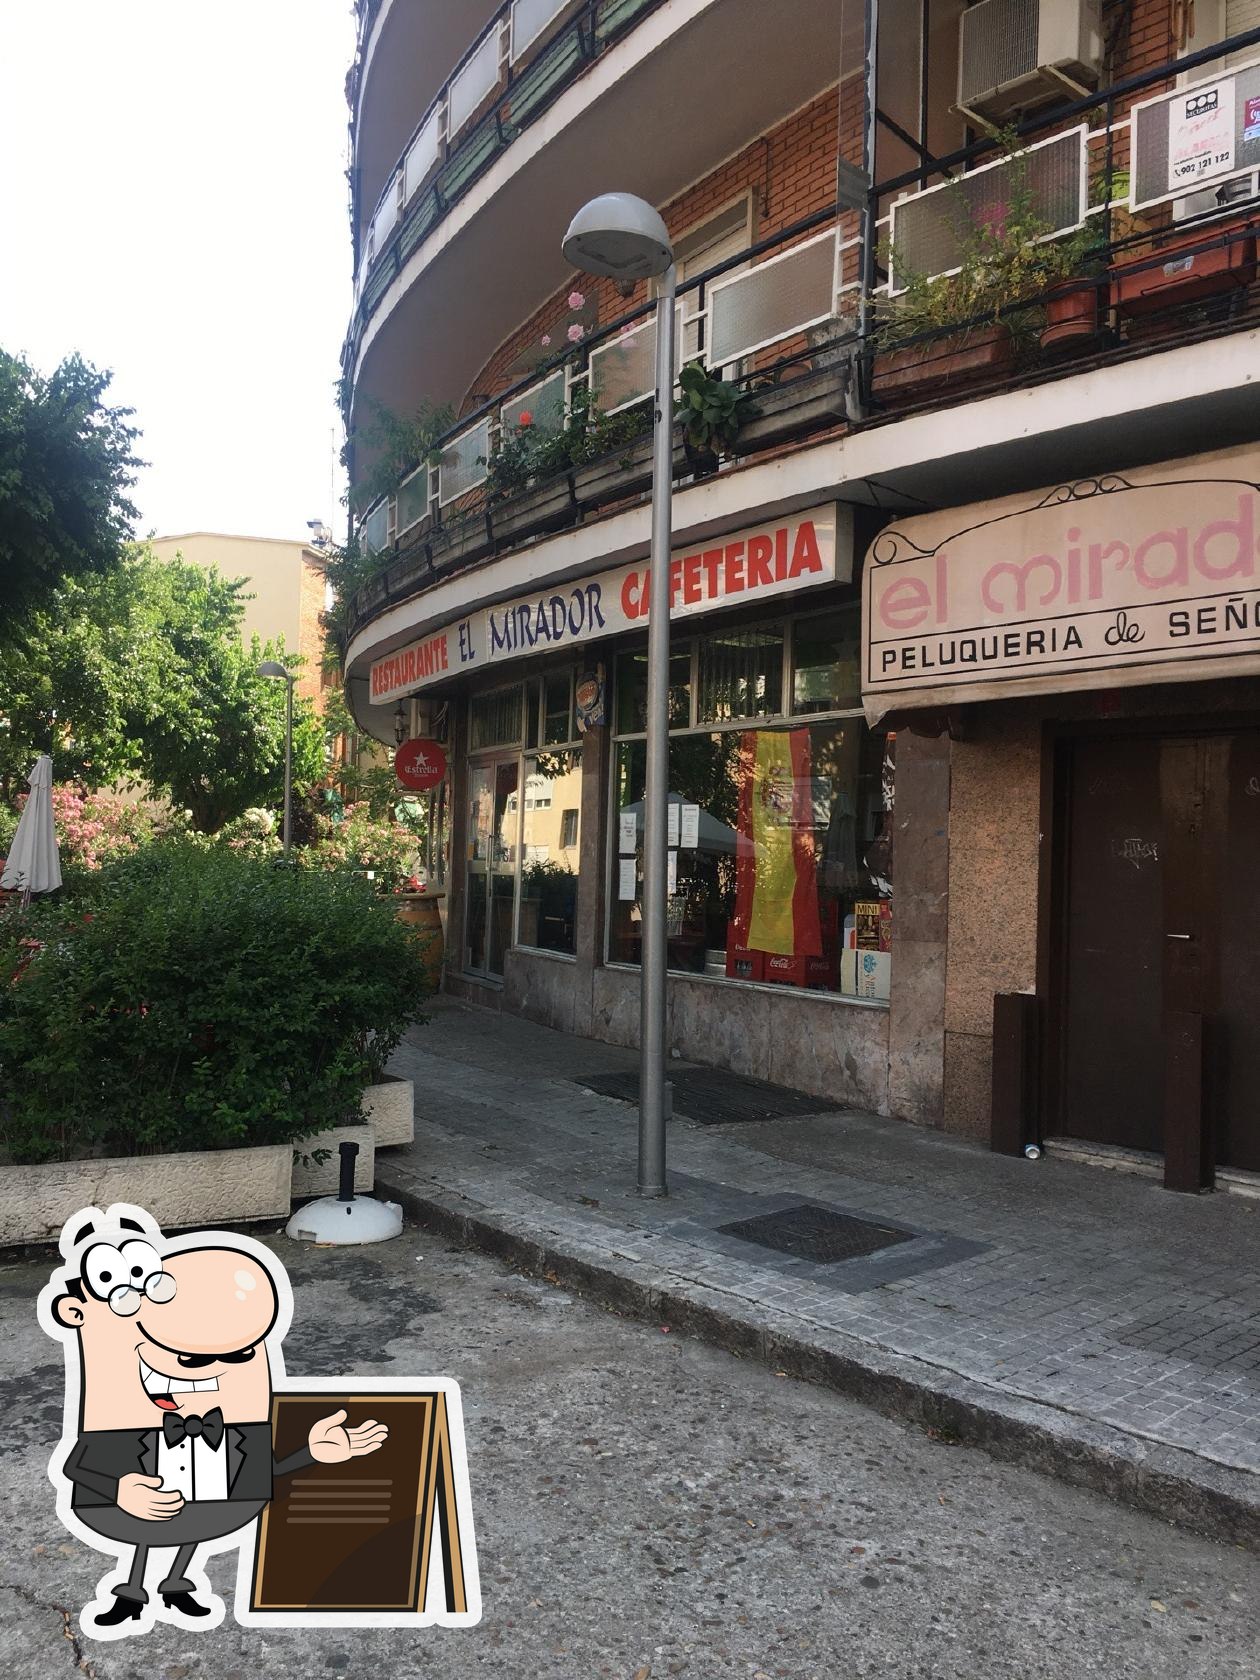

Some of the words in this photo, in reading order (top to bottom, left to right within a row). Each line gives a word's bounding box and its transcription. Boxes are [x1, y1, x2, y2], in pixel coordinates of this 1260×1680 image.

[1181, 163, 1196, 175] 902
[1198, 157, 1212, 169] 121
[1215, 151, 1230, 163] 122
[879, 553, 948, 630] el
[981, 494, 1260, 614] mirad
[372, 634, 449, 696] RESTAURANTE
[458, 619, 476, 662] EL
[489, 582, 606, 656] MIRADOR
[882, 625, 1084, 673] PELUQUERIA
[1104, 611, 1146, 646] de
[1168, 597, 1260, 638] SEÑ
[857, 904, 878, 915] MINI
